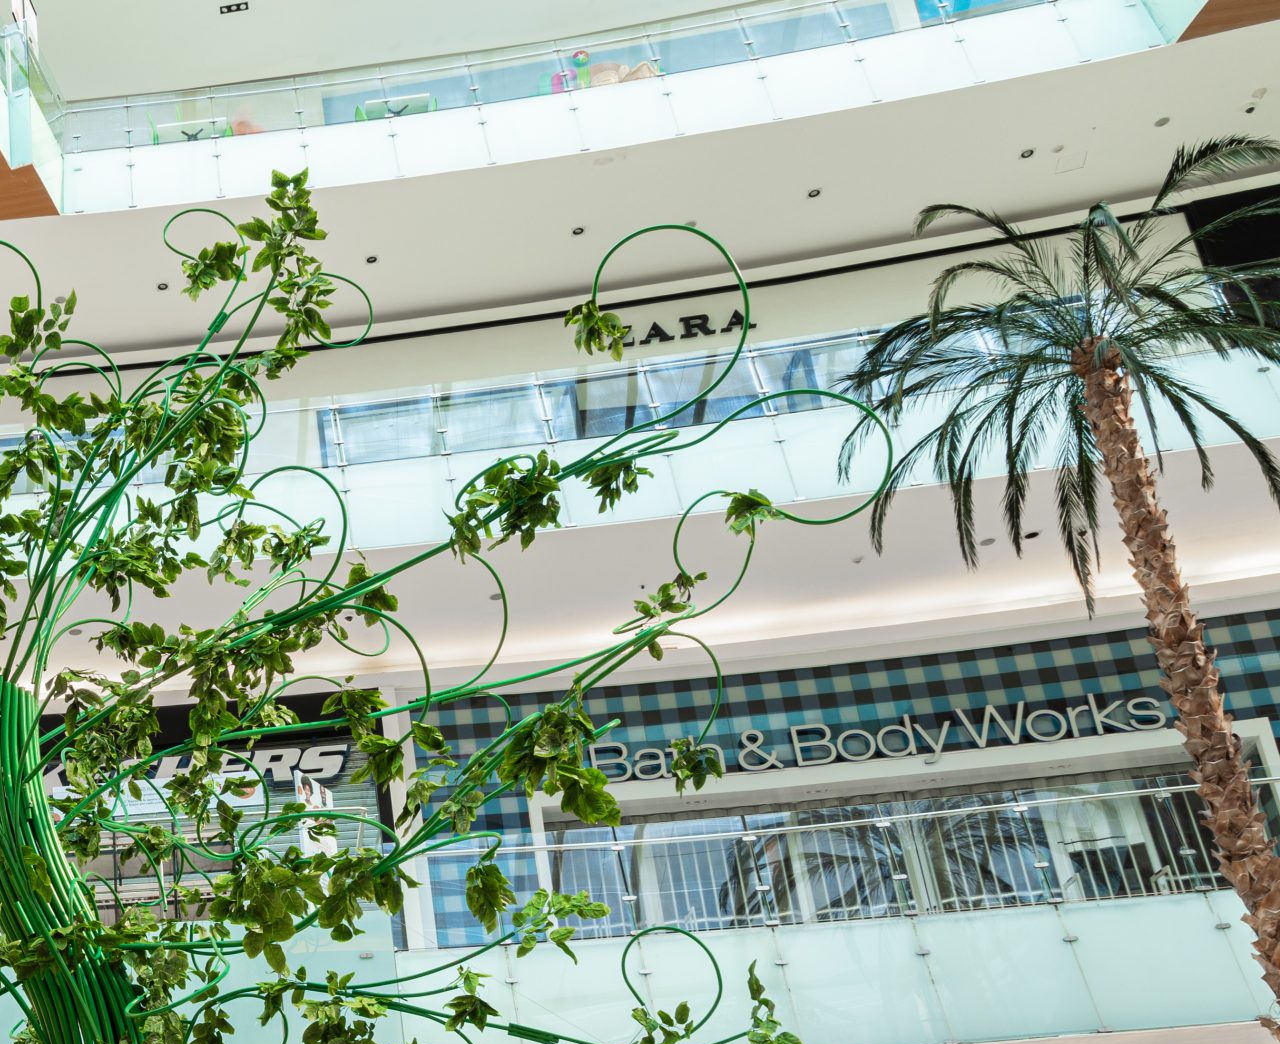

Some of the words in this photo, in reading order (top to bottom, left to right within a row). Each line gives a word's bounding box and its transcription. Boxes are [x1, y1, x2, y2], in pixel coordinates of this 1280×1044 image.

[607, 309, 757, 350] ZARA
[588, 736, 727, 782] Bah
[737, 728, 785, 771] &
[790, 713, 951, 767] Body
[955, 693, 1167, 748] Works
